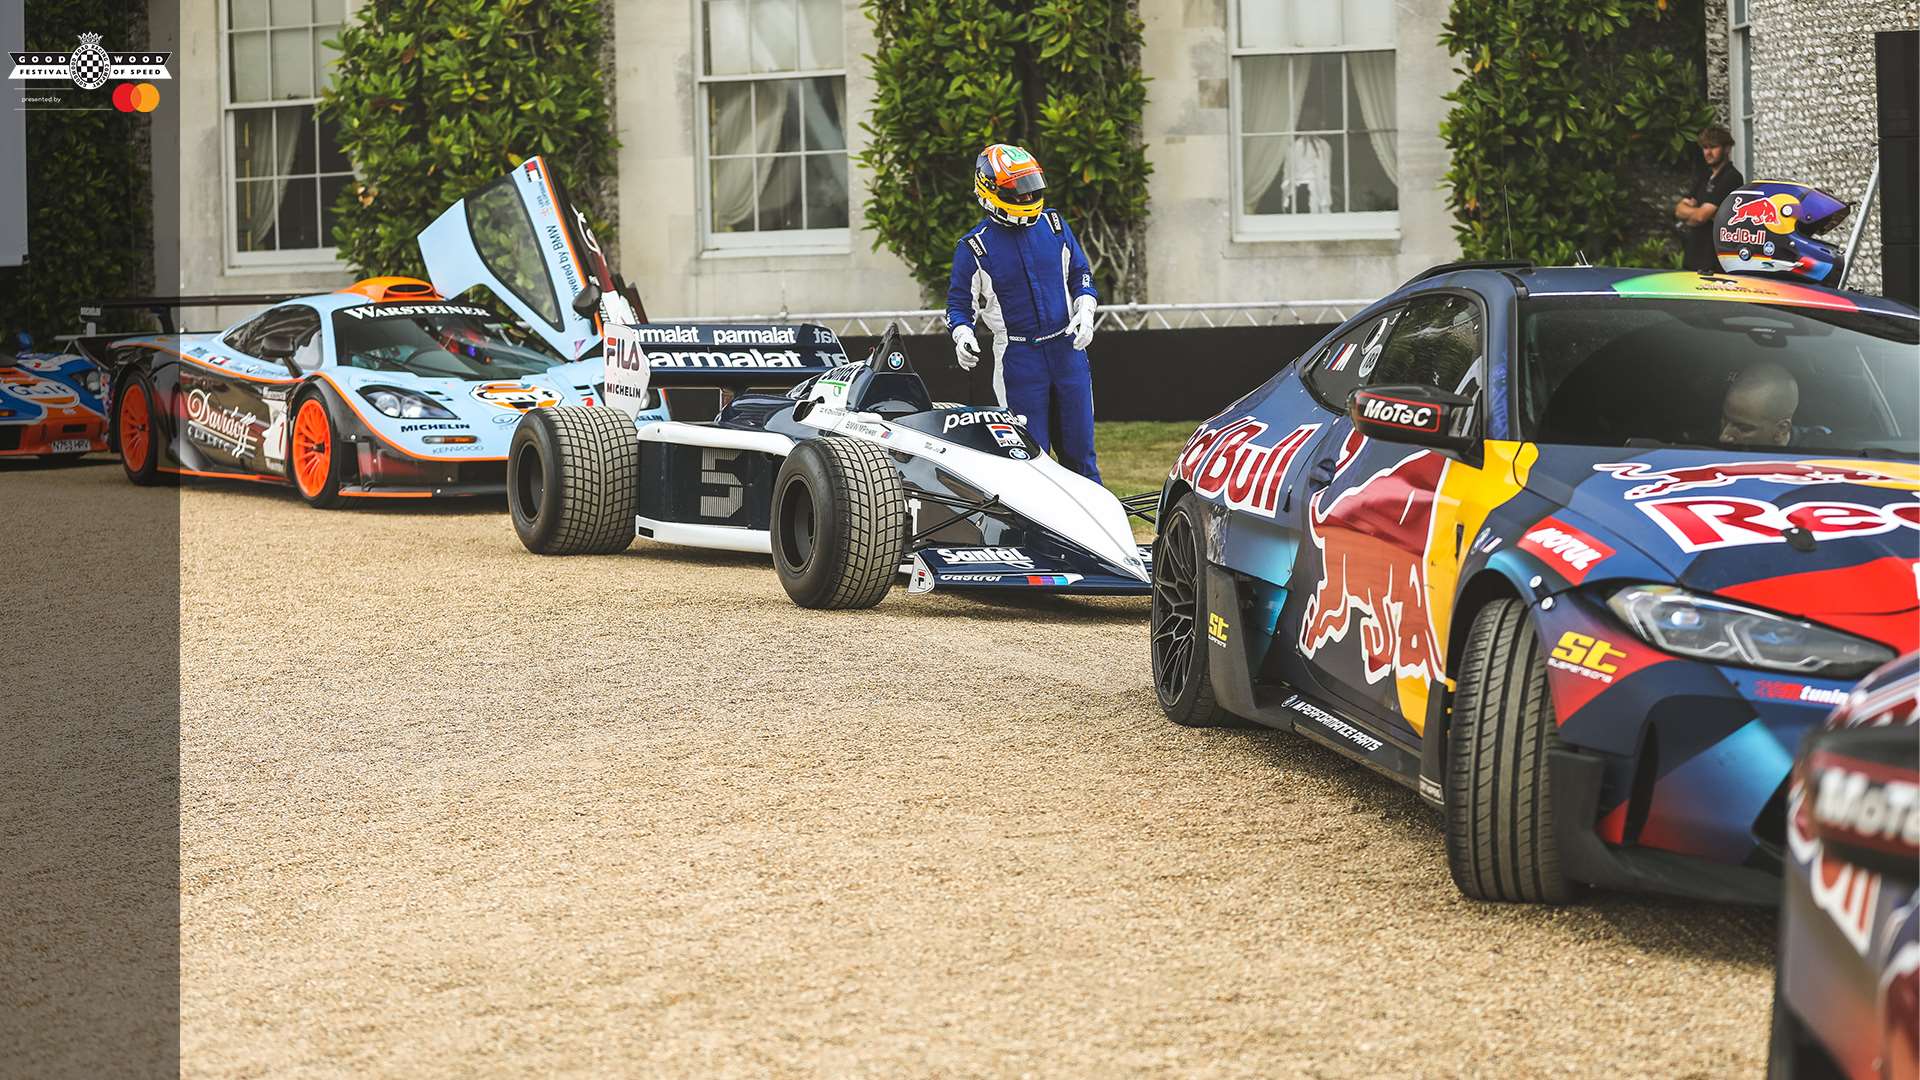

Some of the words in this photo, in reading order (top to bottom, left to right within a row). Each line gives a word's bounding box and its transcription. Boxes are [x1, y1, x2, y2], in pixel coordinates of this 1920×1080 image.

[547, 225, 564, 252] BMW
[1719, 227, 1740, 243] Red
[1740, 229, 1766, 245] Bull
[561, 263, 581, 298] owered
[344, 305, 491, 320] WARSTEINER
[632, 326, 699, 344] armalat
[713, 327, 796, 345] parmalat
[606, 337, 640, 371] FILA
[648, 349, 806, 368] armalat
[606, 383, 641, 398] MICHELIN
[1362, 398, 1432, 428] MoTeC
[400, 423, 470, 433] MICHELIN
[700, 447, 743, 518] 5
[1525, 527, 1603, 571] MOTUL
[1799, 683, 1849, 707] tunin
[1301, 702, 1357, 739] PERFORMANCE
[1349, 730, 1384, 752] PARTS
